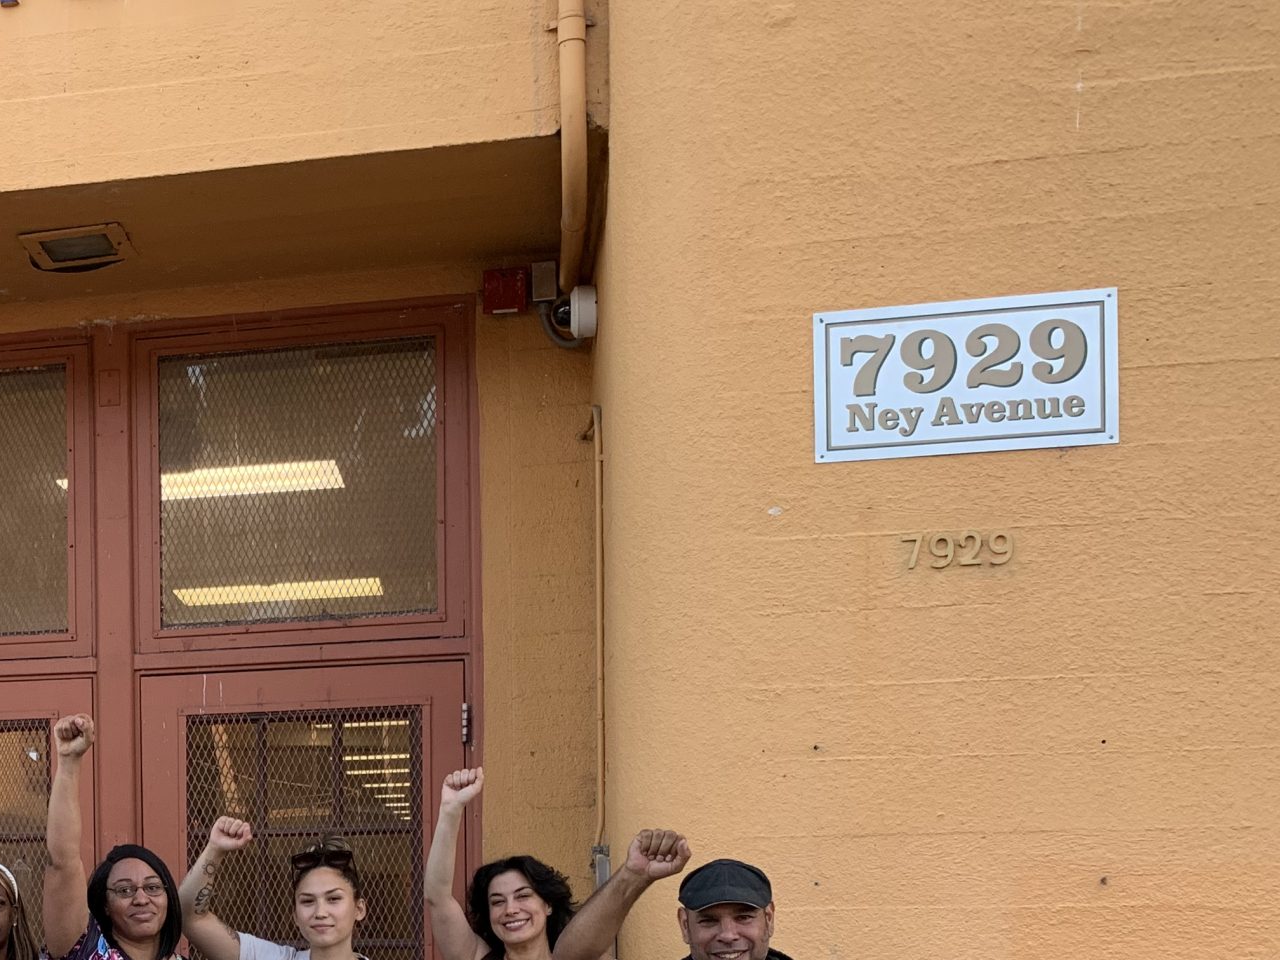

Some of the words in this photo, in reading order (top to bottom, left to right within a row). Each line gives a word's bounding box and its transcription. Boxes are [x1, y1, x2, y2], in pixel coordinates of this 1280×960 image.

[840, 319, 1088, 396] 7929
[846, 402, 923, 437] Ney
[931, 395, 1085, 426] Avenue
[900, 530, 1014, 570] 7929
